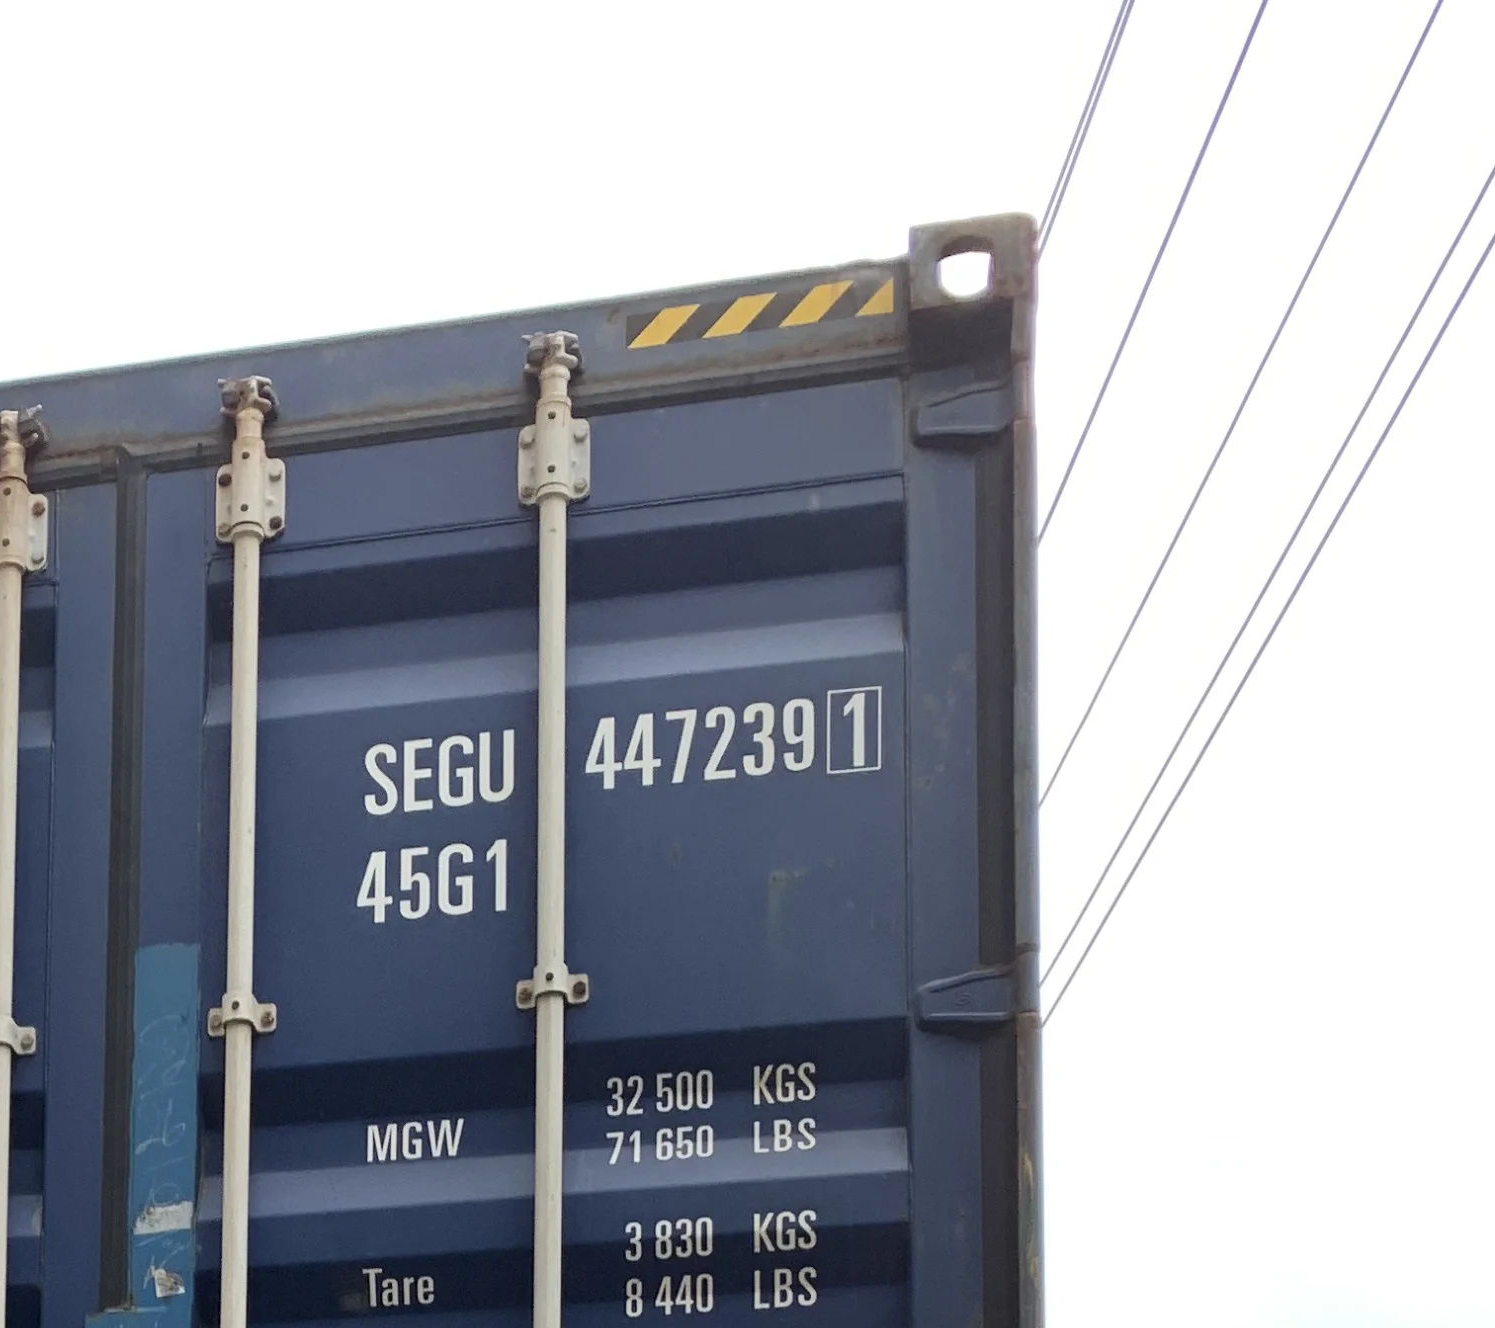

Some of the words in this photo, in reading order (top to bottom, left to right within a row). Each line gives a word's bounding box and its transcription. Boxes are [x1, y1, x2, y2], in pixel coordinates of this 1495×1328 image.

[364, 729, 516, 816] SEGU
[585, 698, 815, 790] 447239
[356, 838, 509, 924] 45G1
[606, 1075, 644, 1117] 32
[655, 1069, 714, 1113] 500
[753, 1061, 817, 1106] KGS
[366, 1118, 465, 1163] MGW
[605, 1129, 642, 1165] 71
[656, 1124, 714, 1161] 650
[753, 1117, 817, 1154] LBS
[624, 1221, 643, 1262] 3
[655, 1217, 713, 1260] 830
[753, 1209, 818, 1253] KGS
[361, 1267, 435, 1307] Tare
[625, 1278, 644, 1318] 8
[654, 1273, 714, 1316] 440
[753, 1266, 818, 1310] LBS
